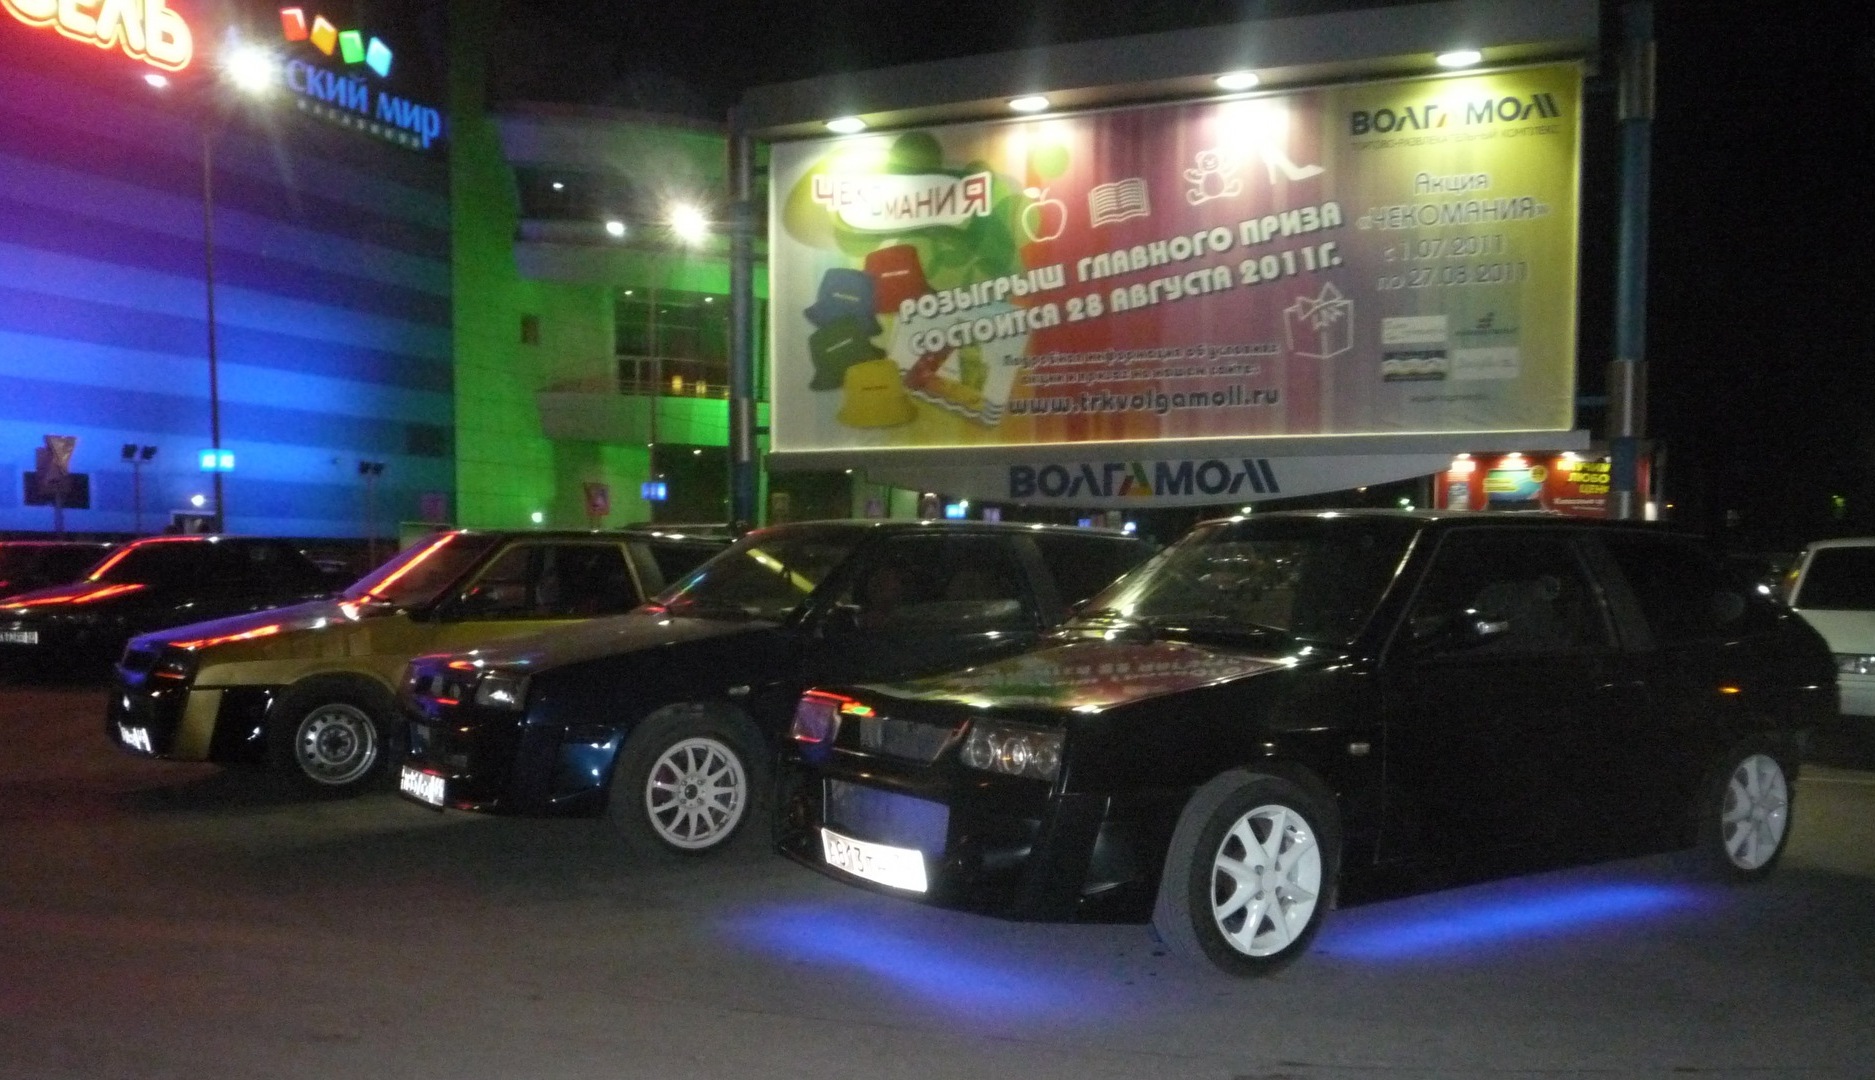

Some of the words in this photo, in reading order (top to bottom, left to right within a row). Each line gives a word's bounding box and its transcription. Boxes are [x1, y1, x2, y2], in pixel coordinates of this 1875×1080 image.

[1414, 171, 1489, 195] Акция
[900, 264, 1066, 324] РОЗЫГРЫШ
[1077, 226, 1234, 283] ГЛАВНОГО
[1239, 201, 1343, 246] ПРИЗА
[911, 302, 1060, 355] СОСТОИТСЯ
[1066, 293, 1105, 323] 28
[1109, 265, 1234, 313] АВГУСТА
[1008, 384, 1279, 415] www.trkvolgamoll.ru
